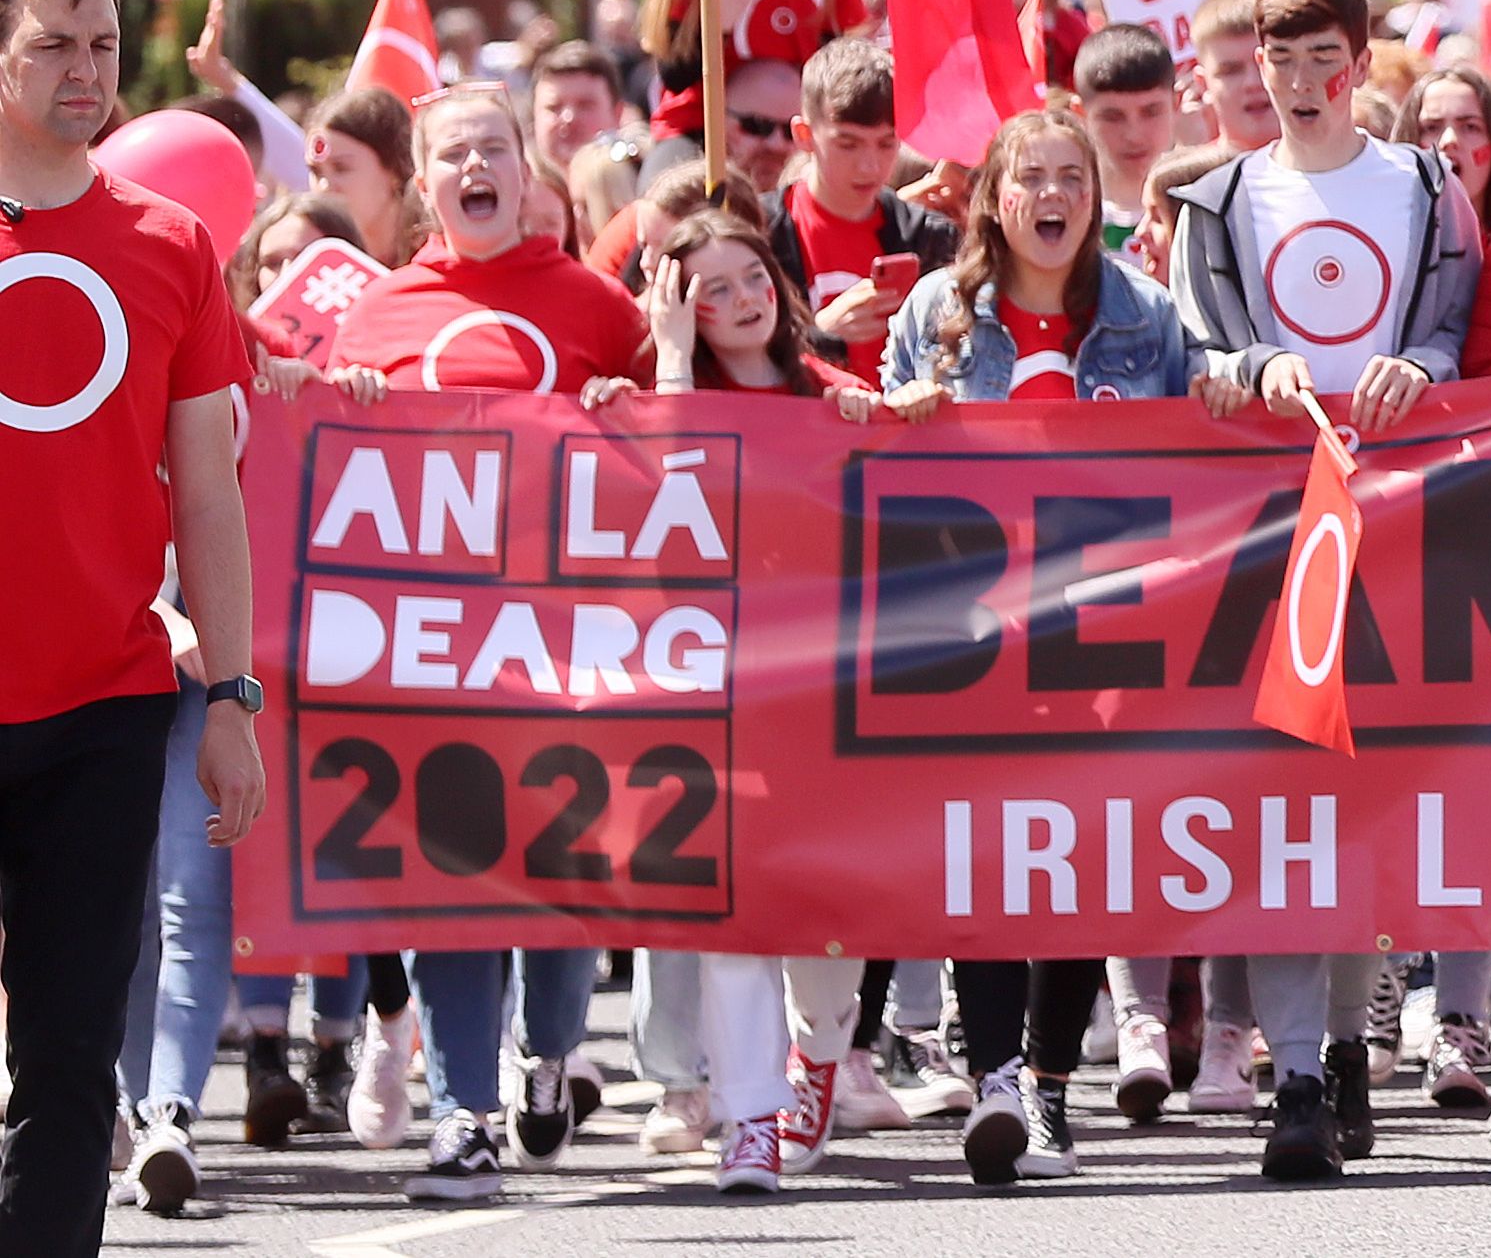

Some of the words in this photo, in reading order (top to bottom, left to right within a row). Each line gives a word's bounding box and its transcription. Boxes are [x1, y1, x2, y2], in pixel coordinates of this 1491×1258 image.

[312, 447, 501, 555] AN
[567, 448, 728, 560] LÁ
[306, 589, 727, 695] DEARG
[309, 739, 718, 887] 2022
[943, 795, 1338, 917] IRISH
